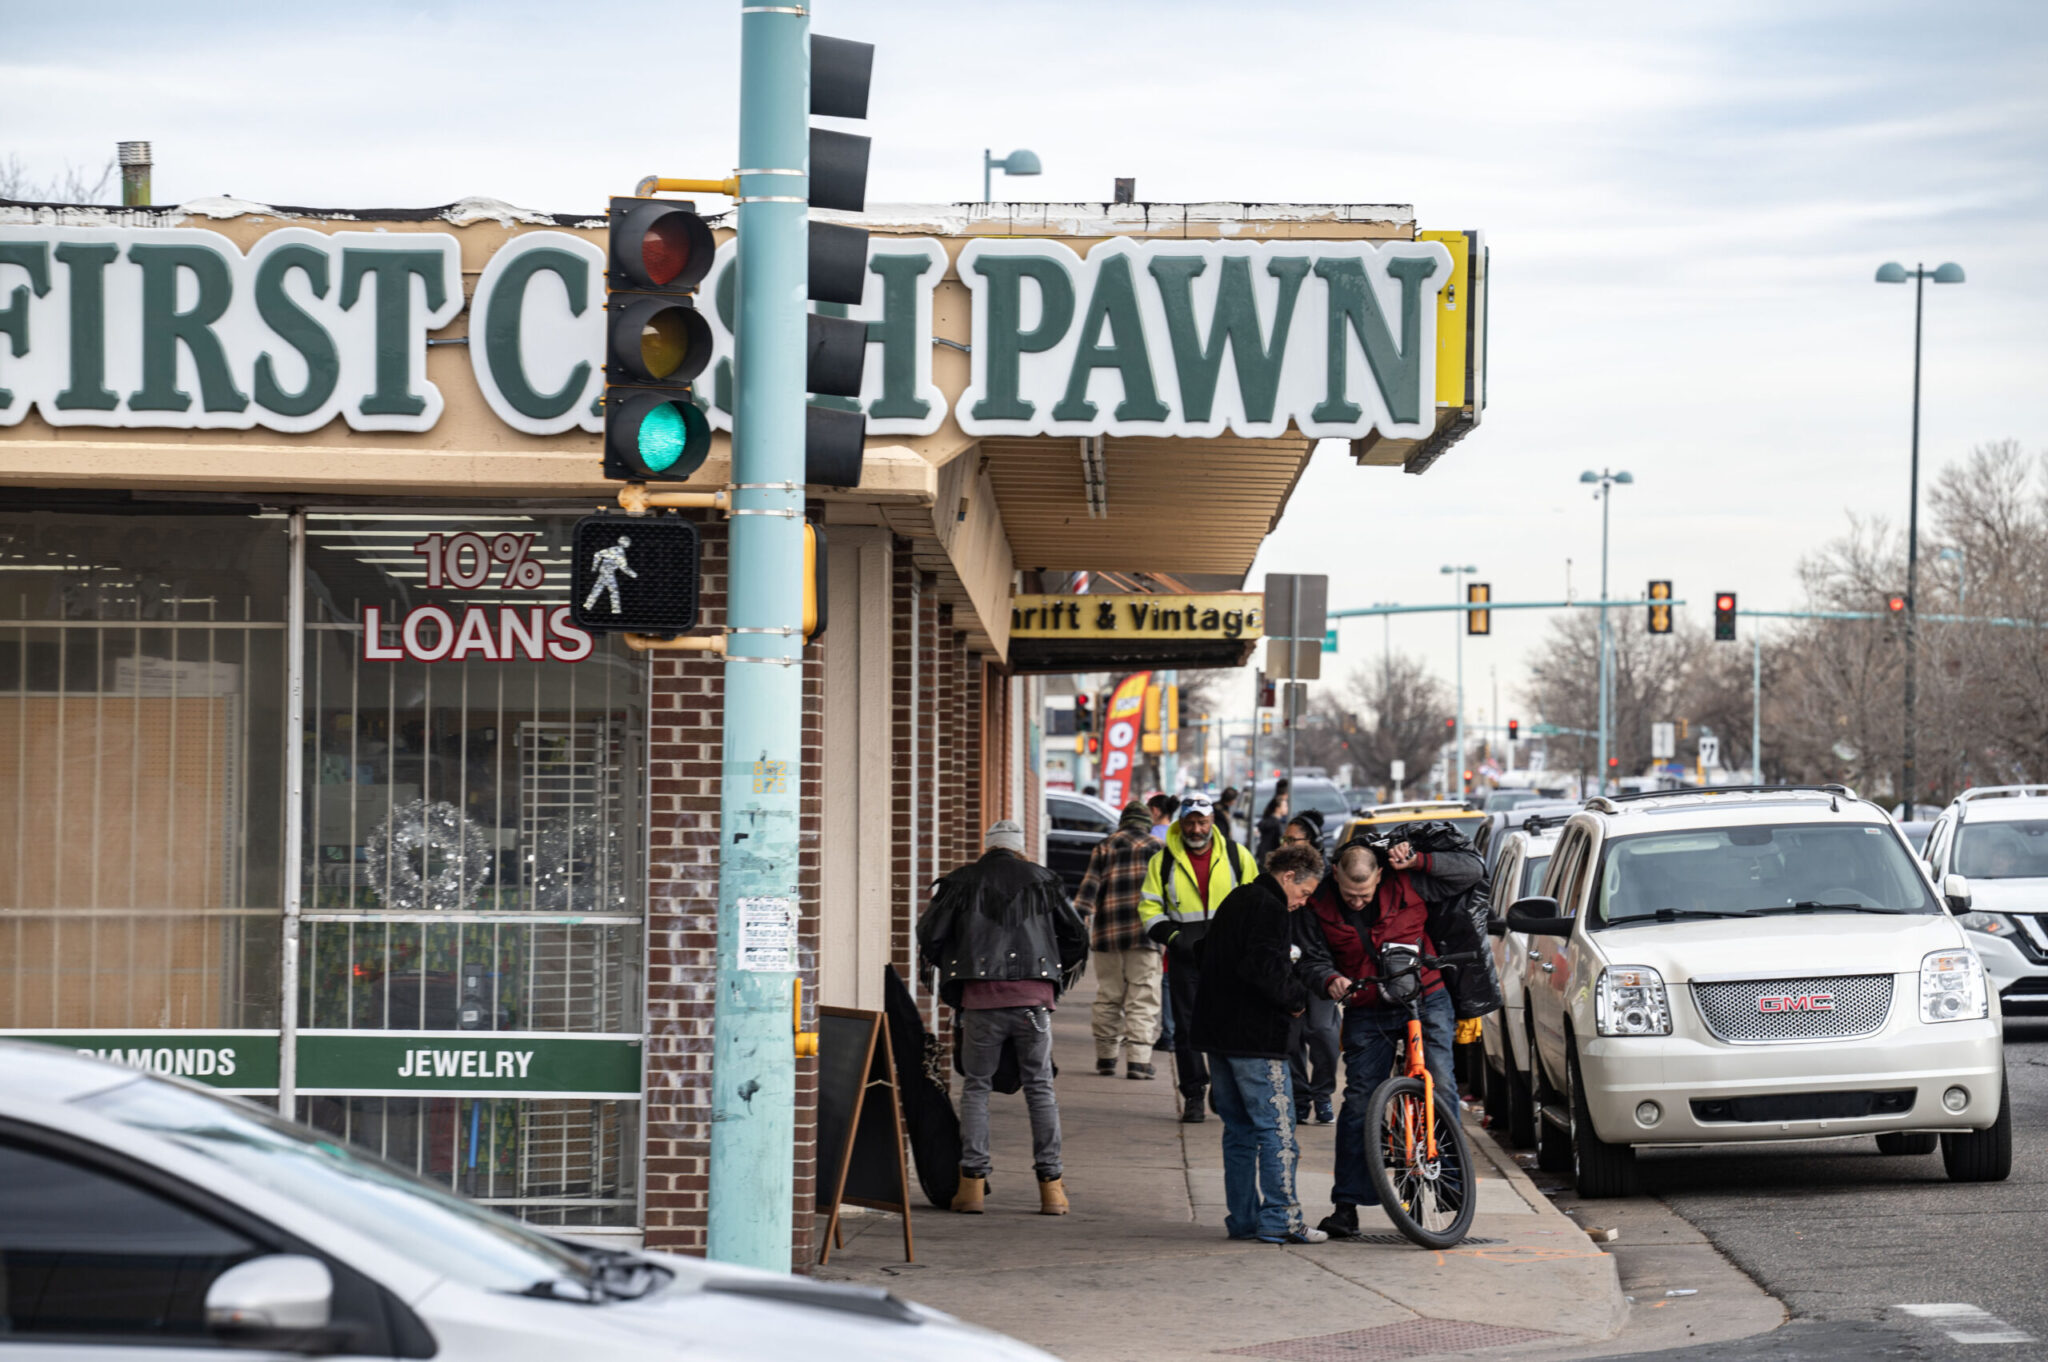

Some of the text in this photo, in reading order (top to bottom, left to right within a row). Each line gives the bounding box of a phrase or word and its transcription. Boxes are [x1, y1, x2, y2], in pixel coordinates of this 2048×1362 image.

[485, 246, 933, 420] CH
[972, 252, 1437, 425] PAWN
[413, 532, 545, 590] 10%
[363, 604, 595, 663] LOANS
[1096, 599, 1118, 631] &
[1129, 599, 1264, 639] Vintage
[1758, 994, 1834, 1013] GMC
[77, 1048, 535, 1078] AMONDS JEWELRY
